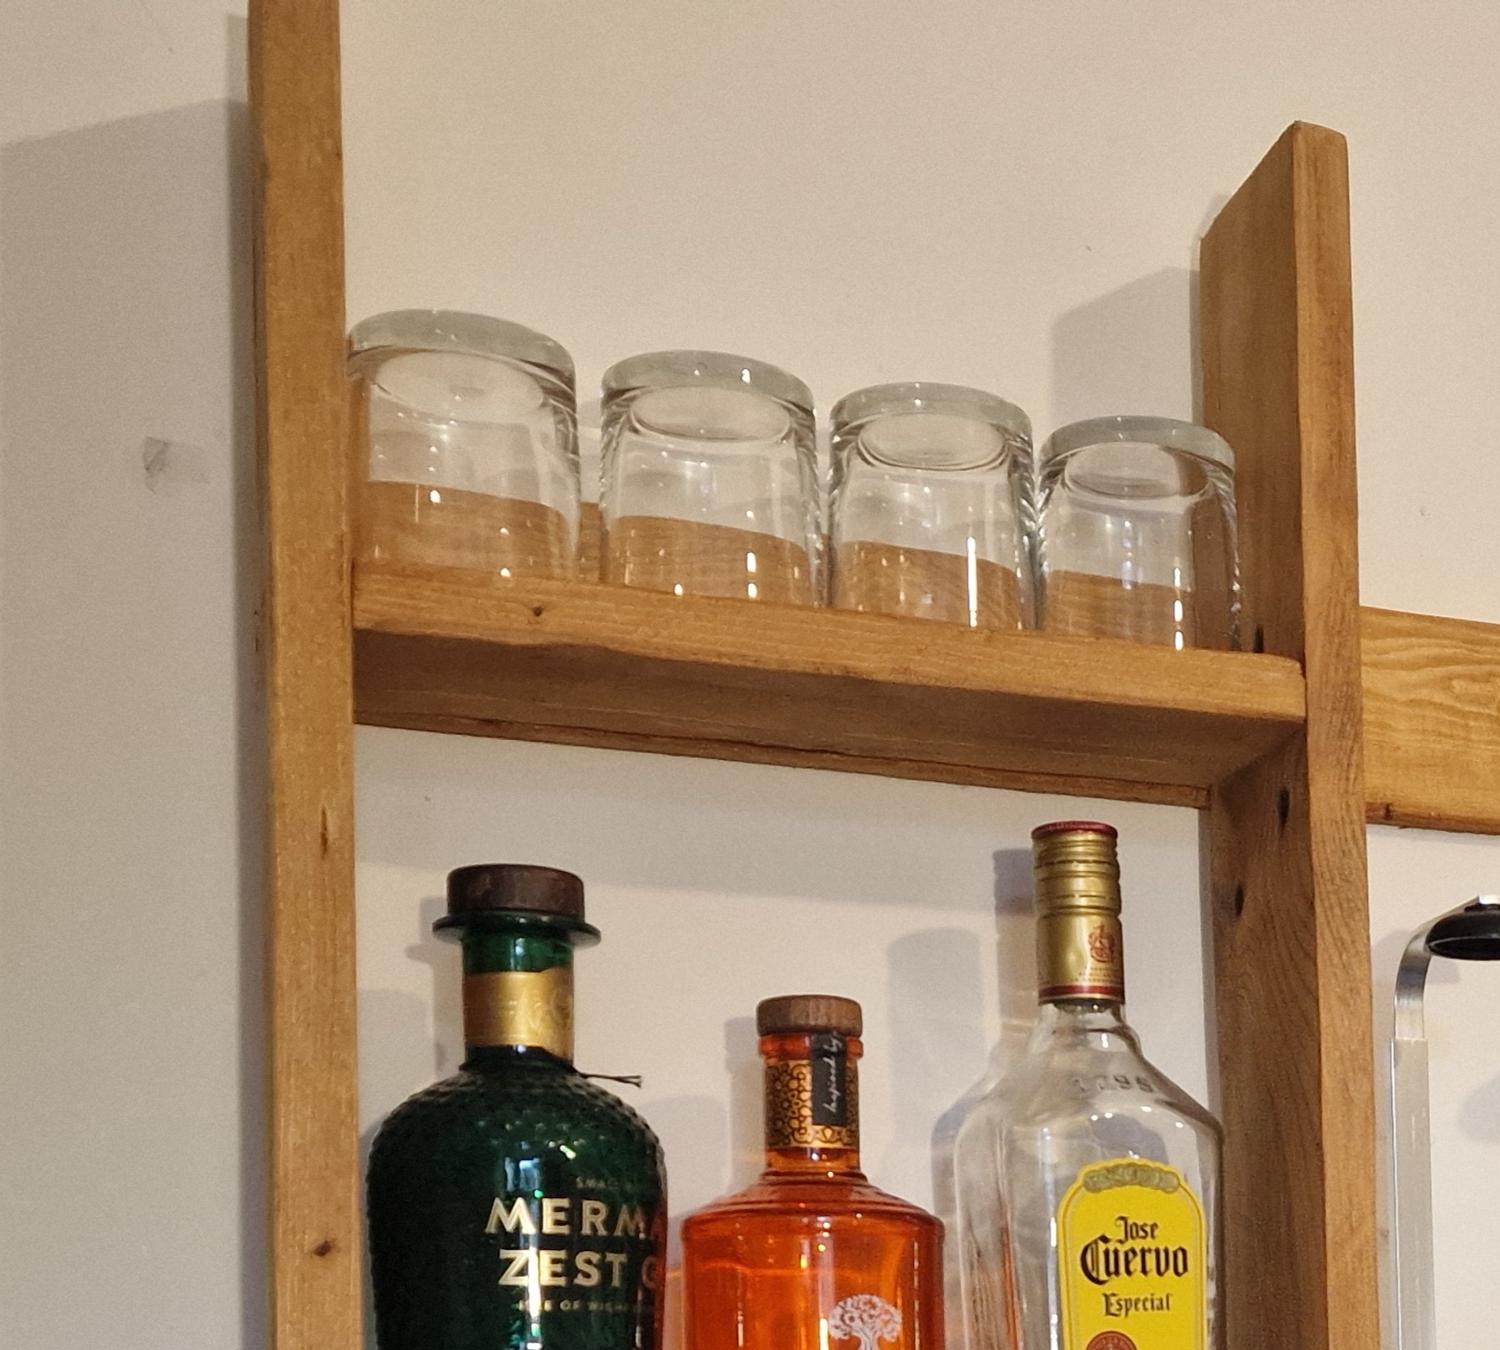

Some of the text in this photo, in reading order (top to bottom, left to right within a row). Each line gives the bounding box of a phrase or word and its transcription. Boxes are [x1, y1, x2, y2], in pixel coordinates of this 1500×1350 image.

[485, 1197, 653, 1240] MERM
[1114, 1216, 1159, 1244] Jose
[498, 1249, 628, 1288] ZEST
[1080, 1234, 1189, 1285] Cuervo
[559, 1301, 581, 1312] OF
[1102, 1292, 1173, 1318] Especial
